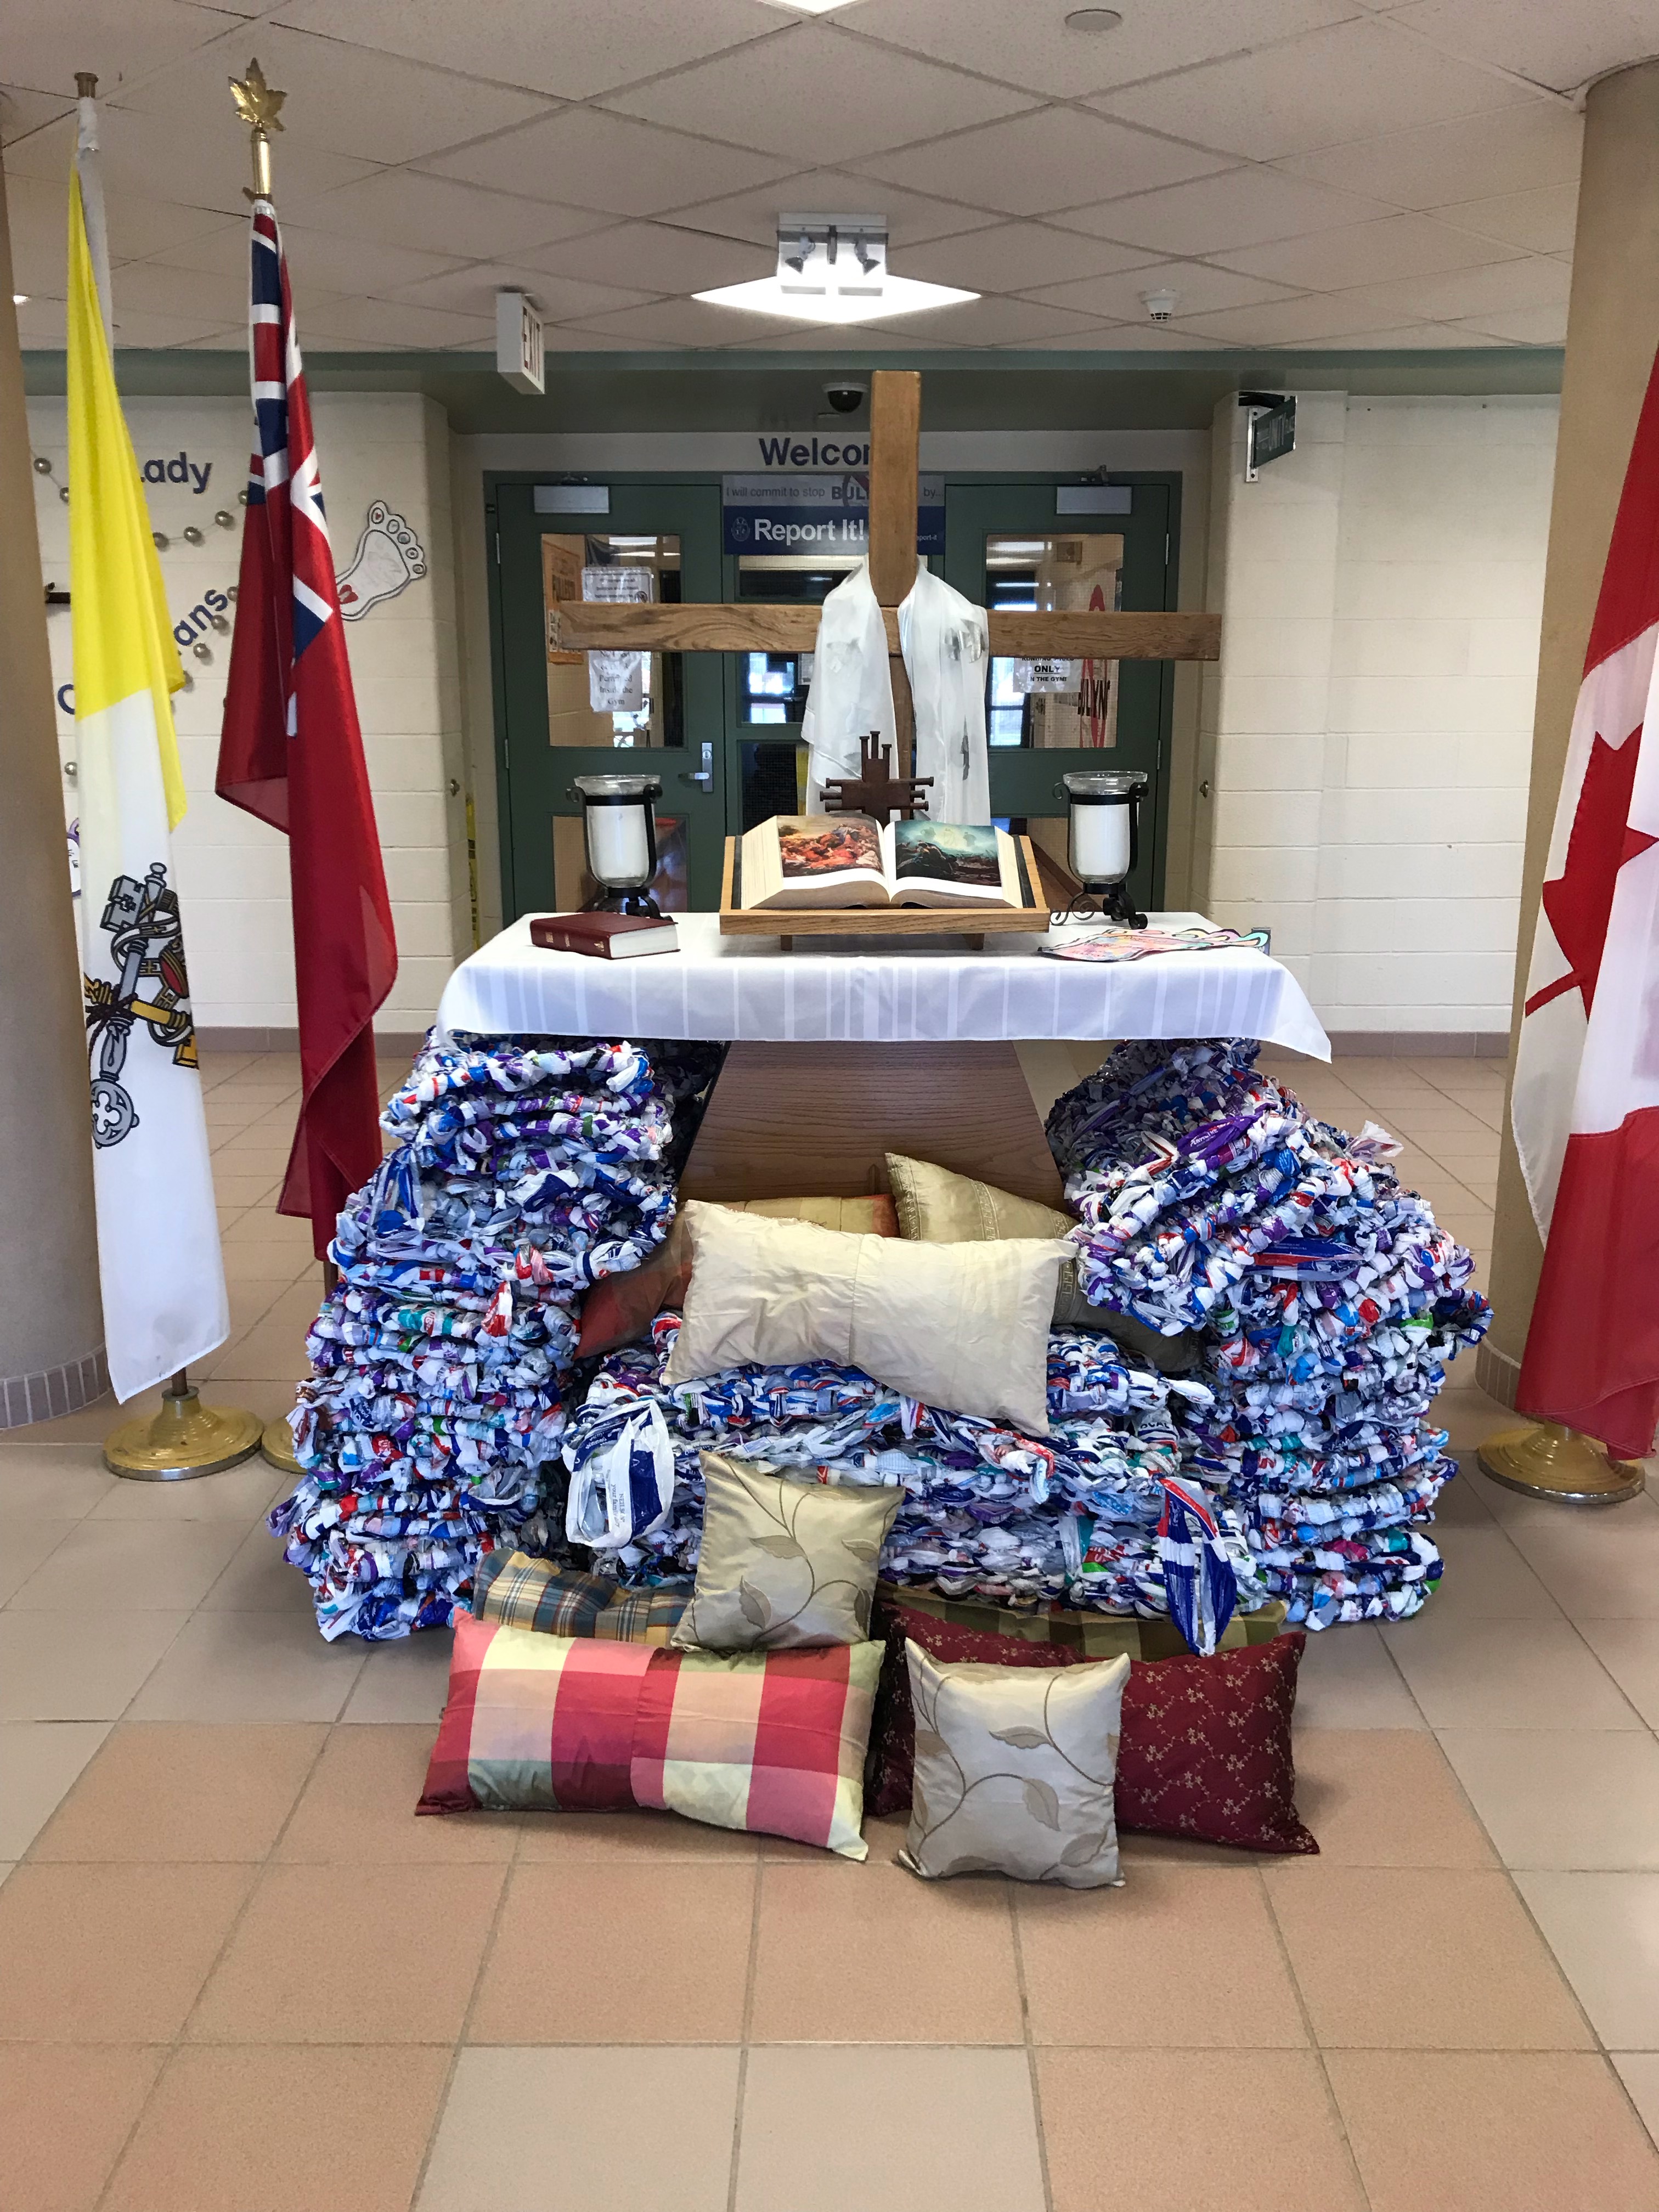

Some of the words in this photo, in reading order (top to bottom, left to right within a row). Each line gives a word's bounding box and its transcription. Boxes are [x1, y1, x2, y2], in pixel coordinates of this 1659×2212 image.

[140, 452, 213, 494] ady
[732, 487, 748, 496] will
[750, 487, 787, 497] commit
[789, 487, 800, 497] to
[803, 487, 826, 498] stop
[754, 518, 836, 546] Report
[842, 519, 864, 540] It!
